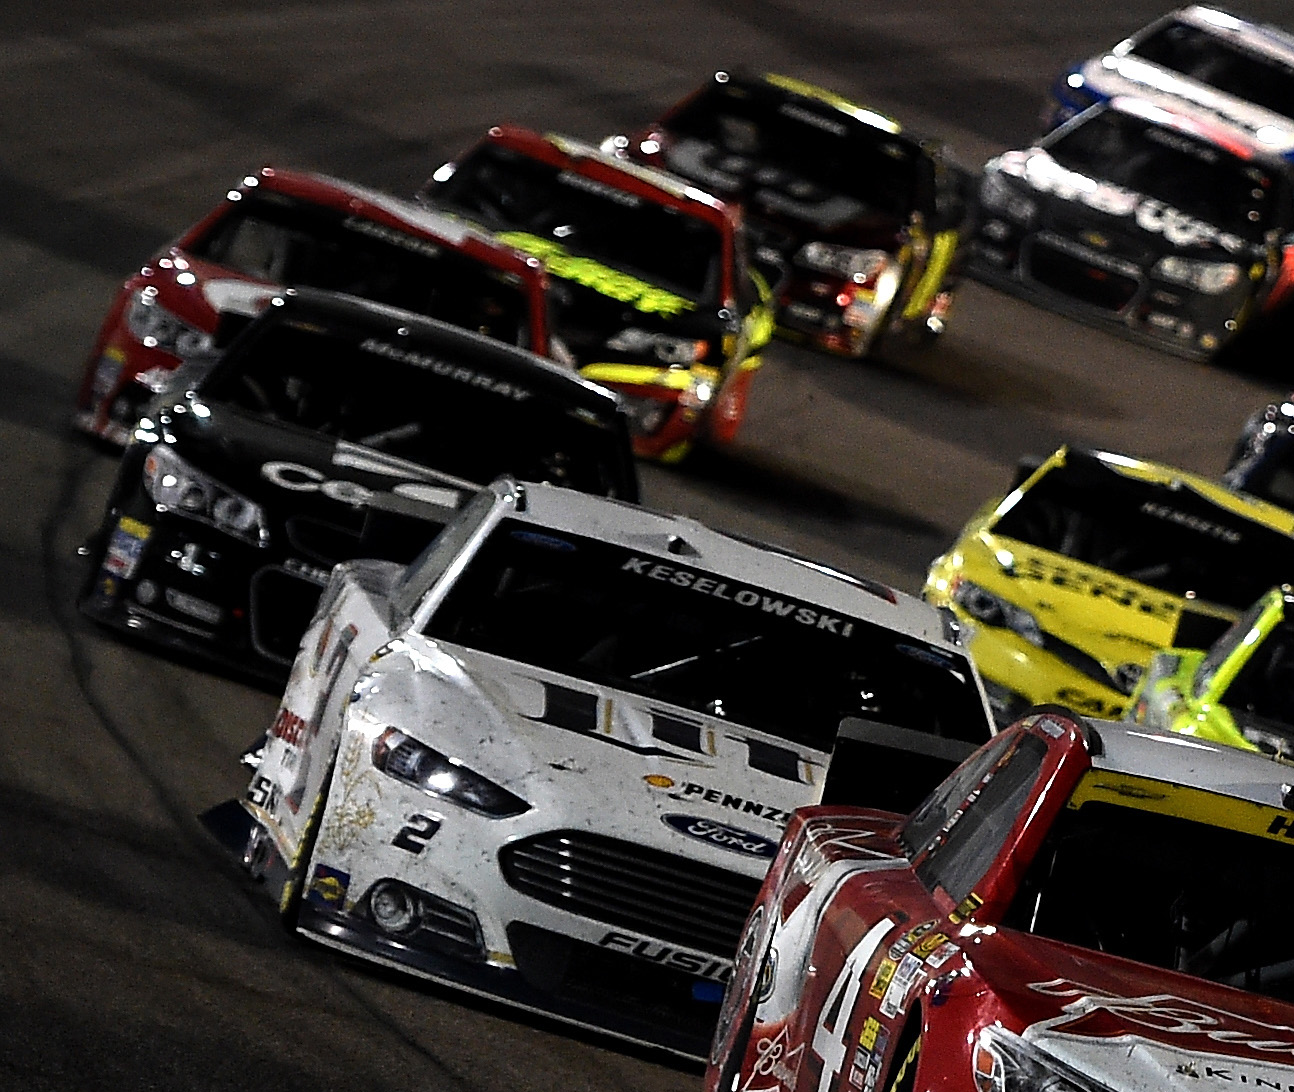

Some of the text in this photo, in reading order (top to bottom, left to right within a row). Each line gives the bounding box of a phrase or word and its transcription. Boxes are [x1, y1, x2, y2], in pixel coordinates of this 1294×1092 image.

[621, 557, 855, 638] KESELOWSKI
[684, 782, 791, 823] PENNZ
[391, 812, 442, 855] 2
[687, 820, 767, 854] Ford
